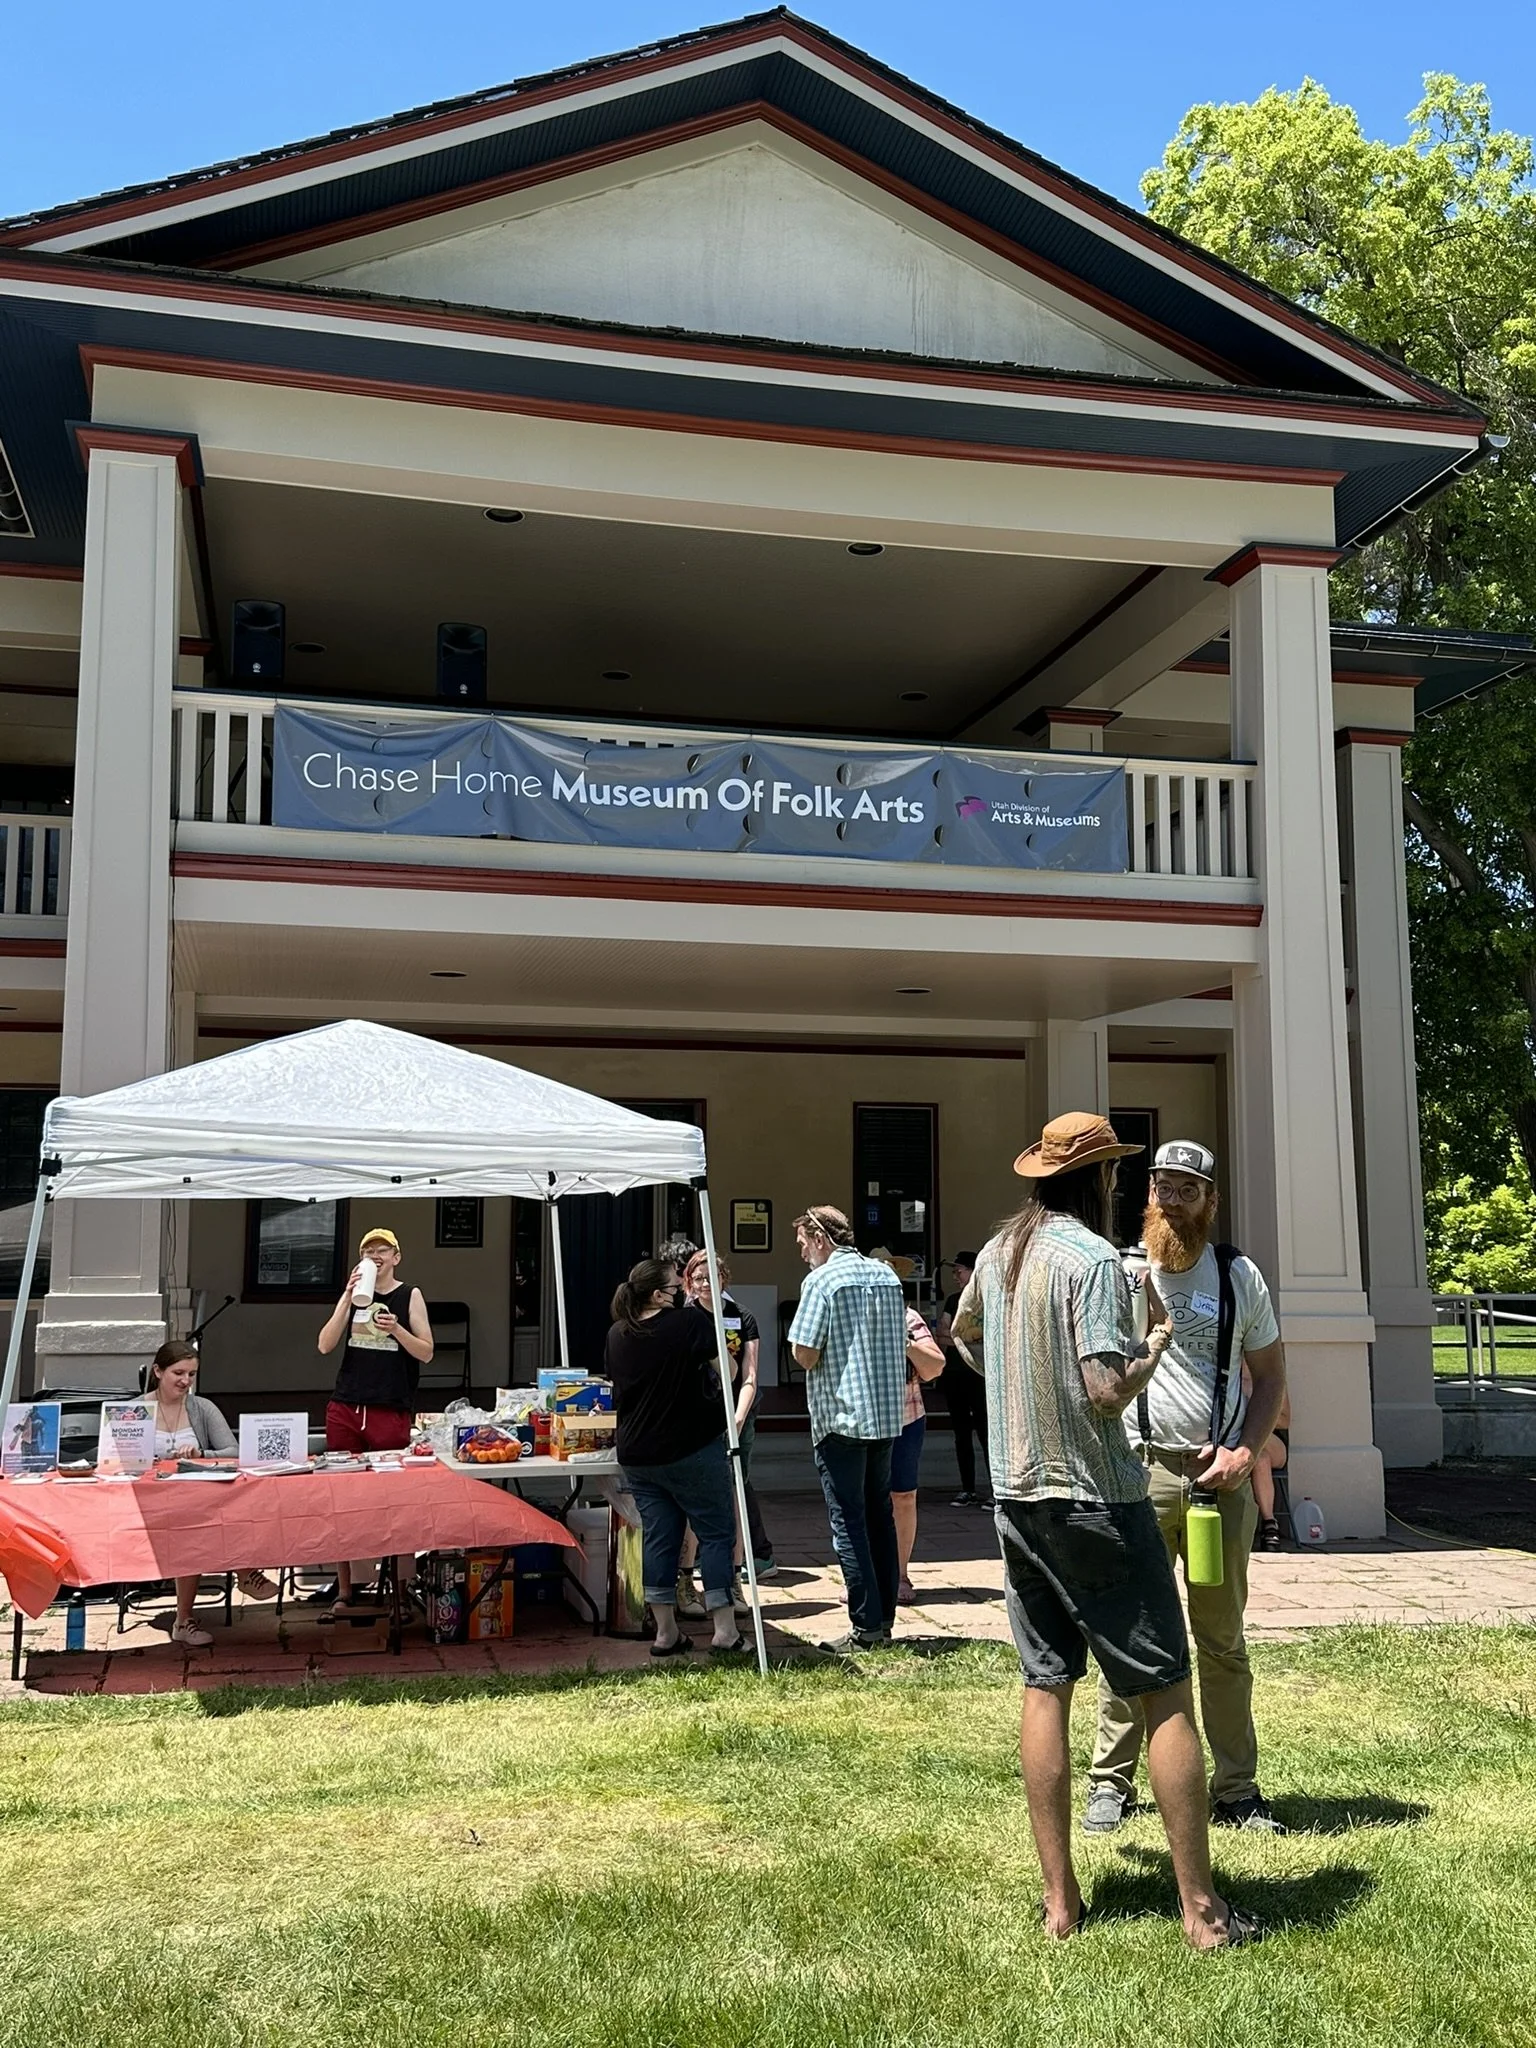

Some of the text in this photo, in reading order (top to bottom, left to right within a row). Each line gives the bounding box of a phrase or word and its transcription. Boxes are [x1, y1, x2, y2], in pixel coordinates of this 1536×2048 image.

[303, 752, 925, 824] Chase Home Museum Of Folk Arts
[991, 801, 1050, 813] Utah Division of
[991, 809, 1101, 828] Arts & Museums
